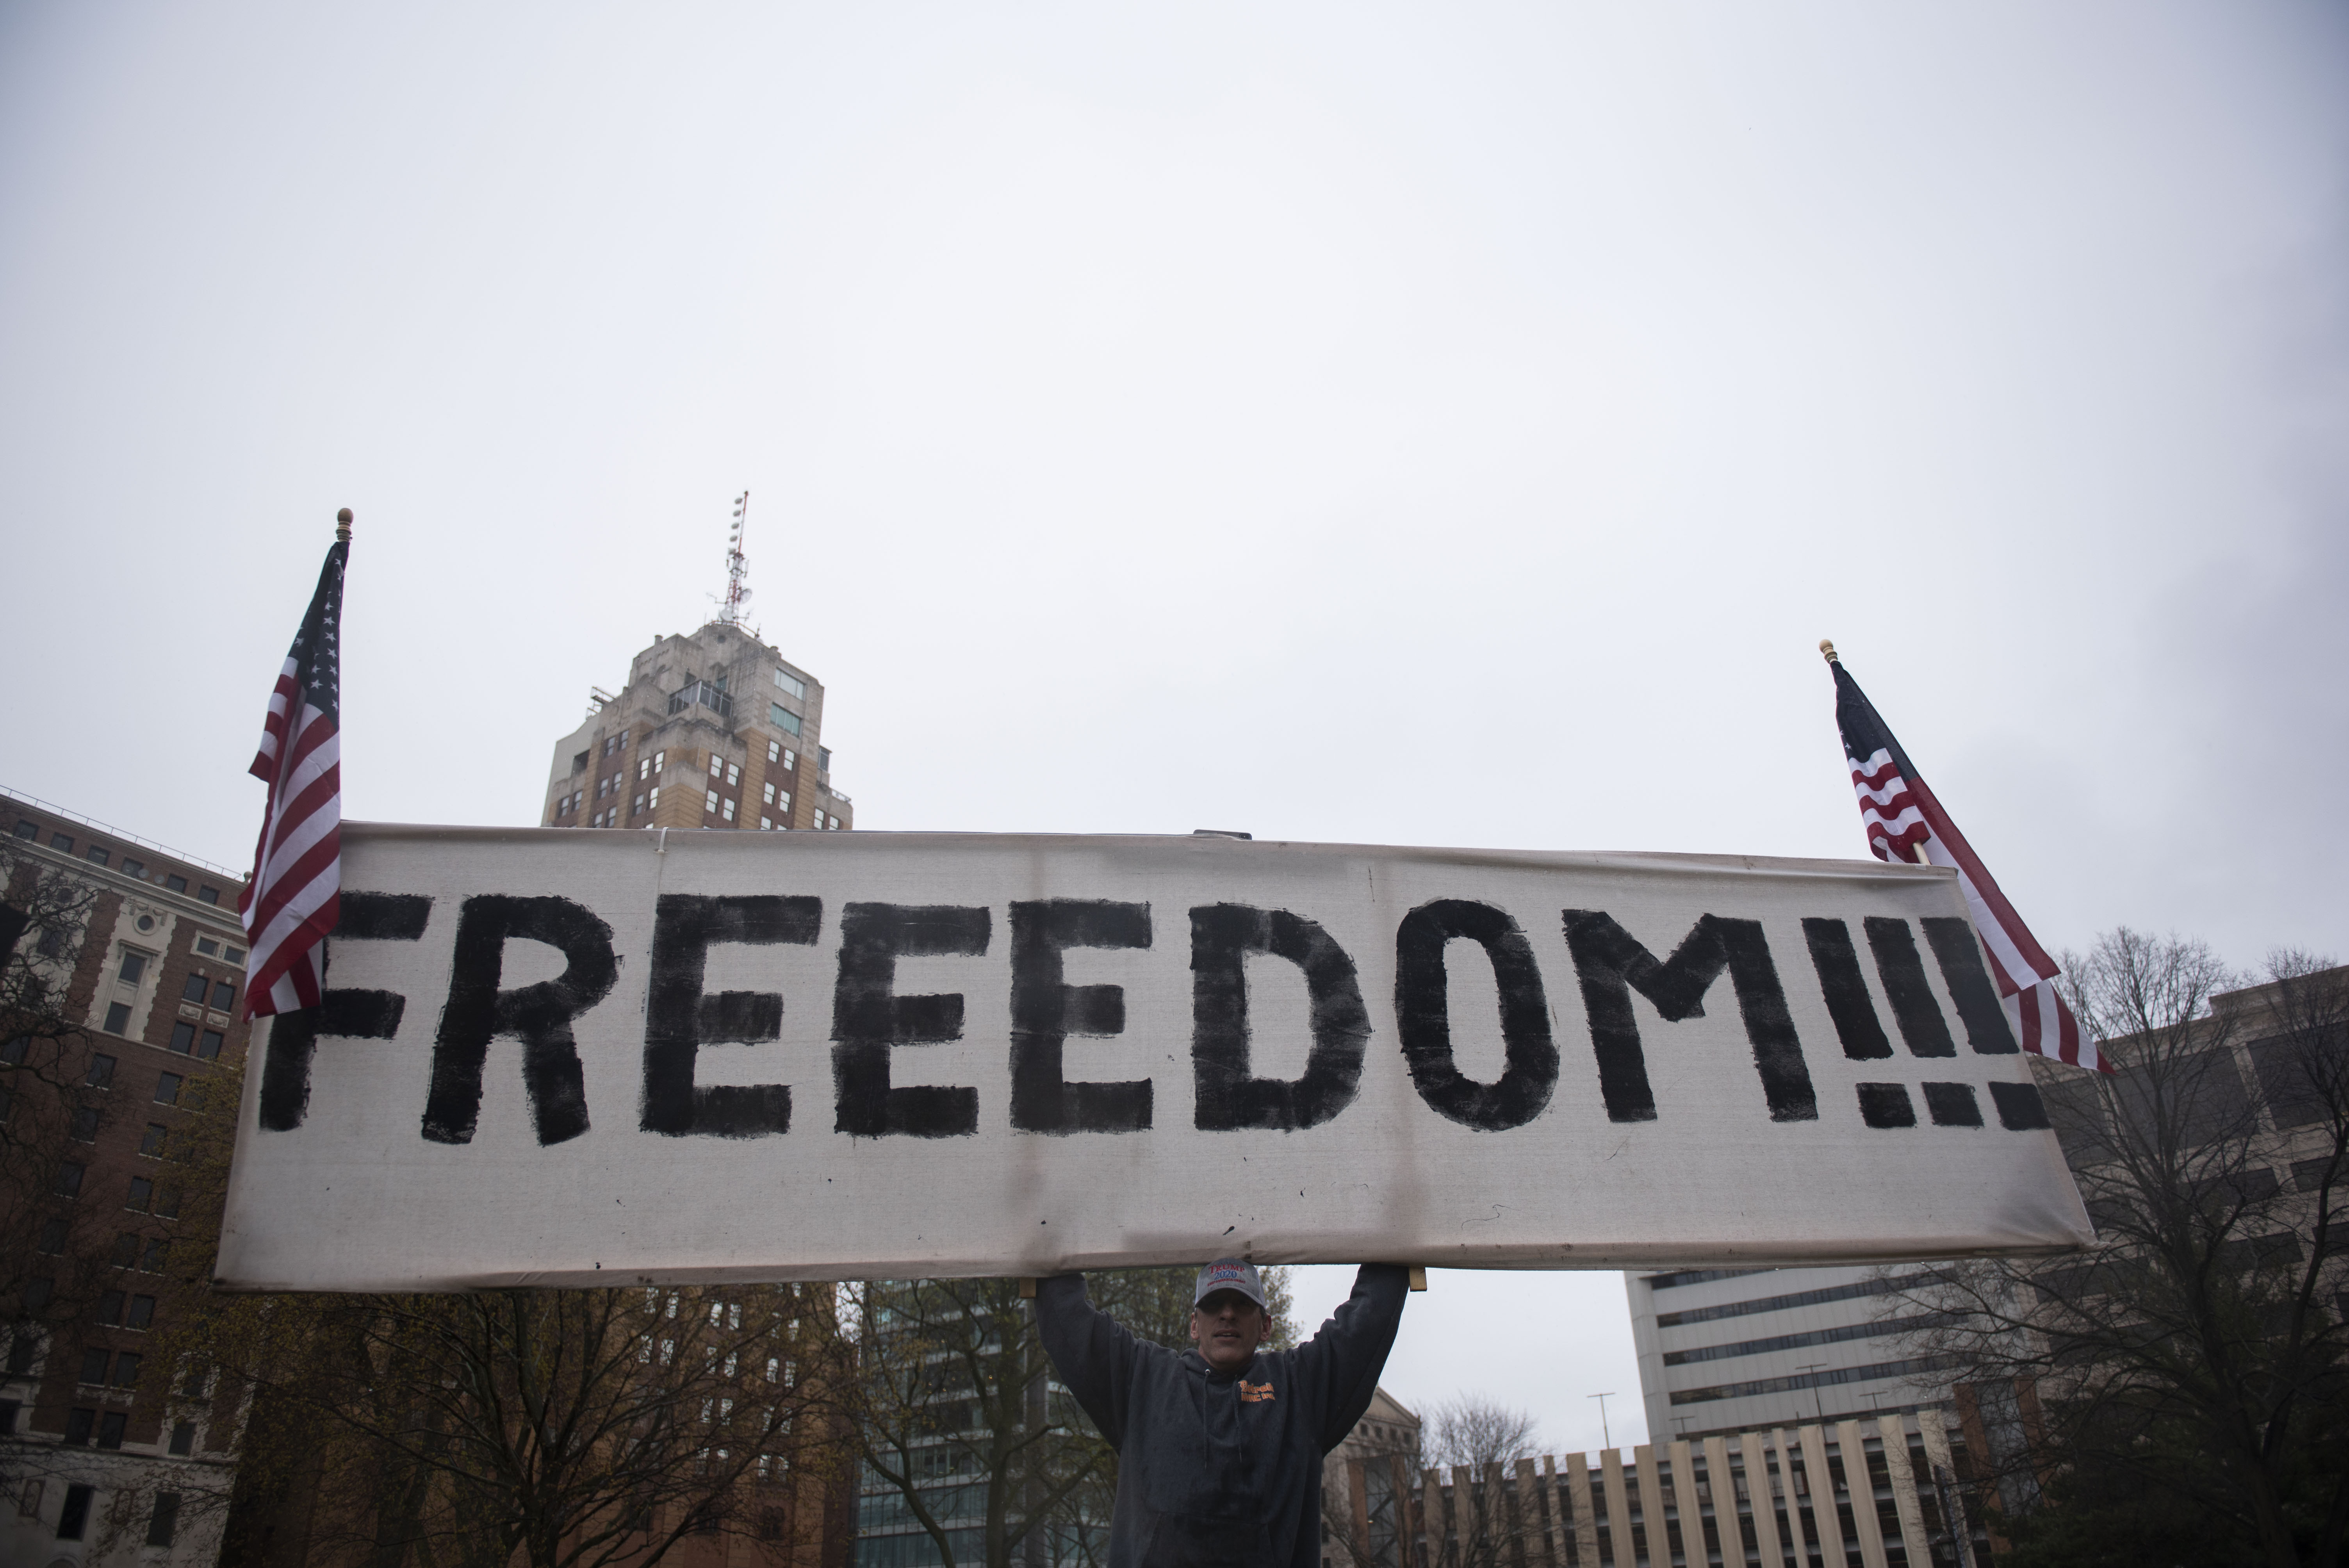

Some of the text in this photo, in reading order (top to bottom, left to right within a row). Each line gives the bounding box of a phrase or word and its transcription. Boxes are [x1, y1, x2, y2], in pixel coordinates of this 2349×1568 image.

[259, 889, 2053, 1147] FREEEDOM!!!
[1208, 1264, 1245, 1274] TRUMP
[1214, 1270, 1237, 1280] 2020
